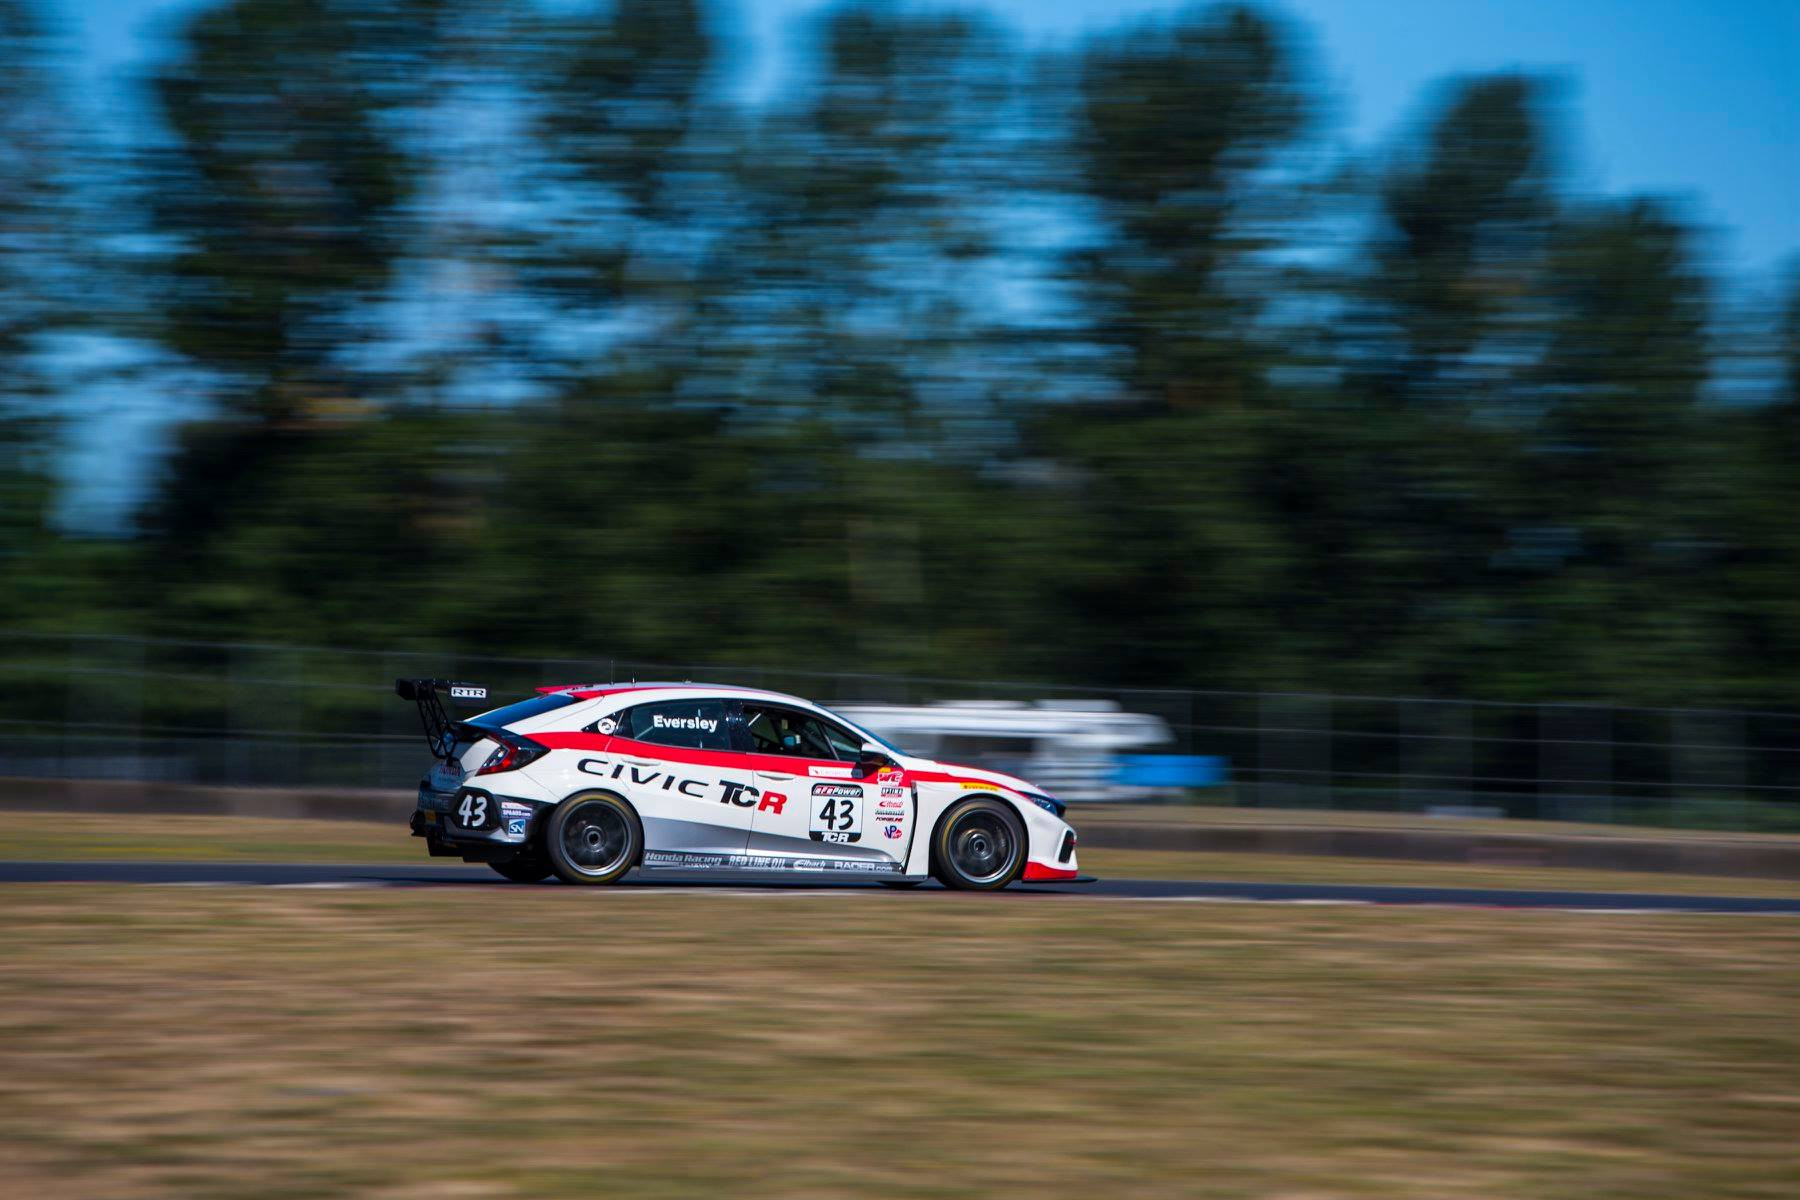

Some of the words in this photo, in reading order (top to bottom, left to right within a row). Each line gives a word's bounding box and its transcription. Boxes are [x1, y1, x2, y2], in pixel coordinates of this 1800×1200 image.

[453, 688, 485, 697] RTR
[653, 715, 718, 733] Eversley
[577, 758, 709, 798] CIVIC
[719, 779, 788, 815] TCR
[459, 794, 487, 827] 43
[819, 798, 854, 831] 43
[821, 833, 849, 843] TCR
[645, 852, 683, 862] Honda
[684, 854, 722, 866] Racing
